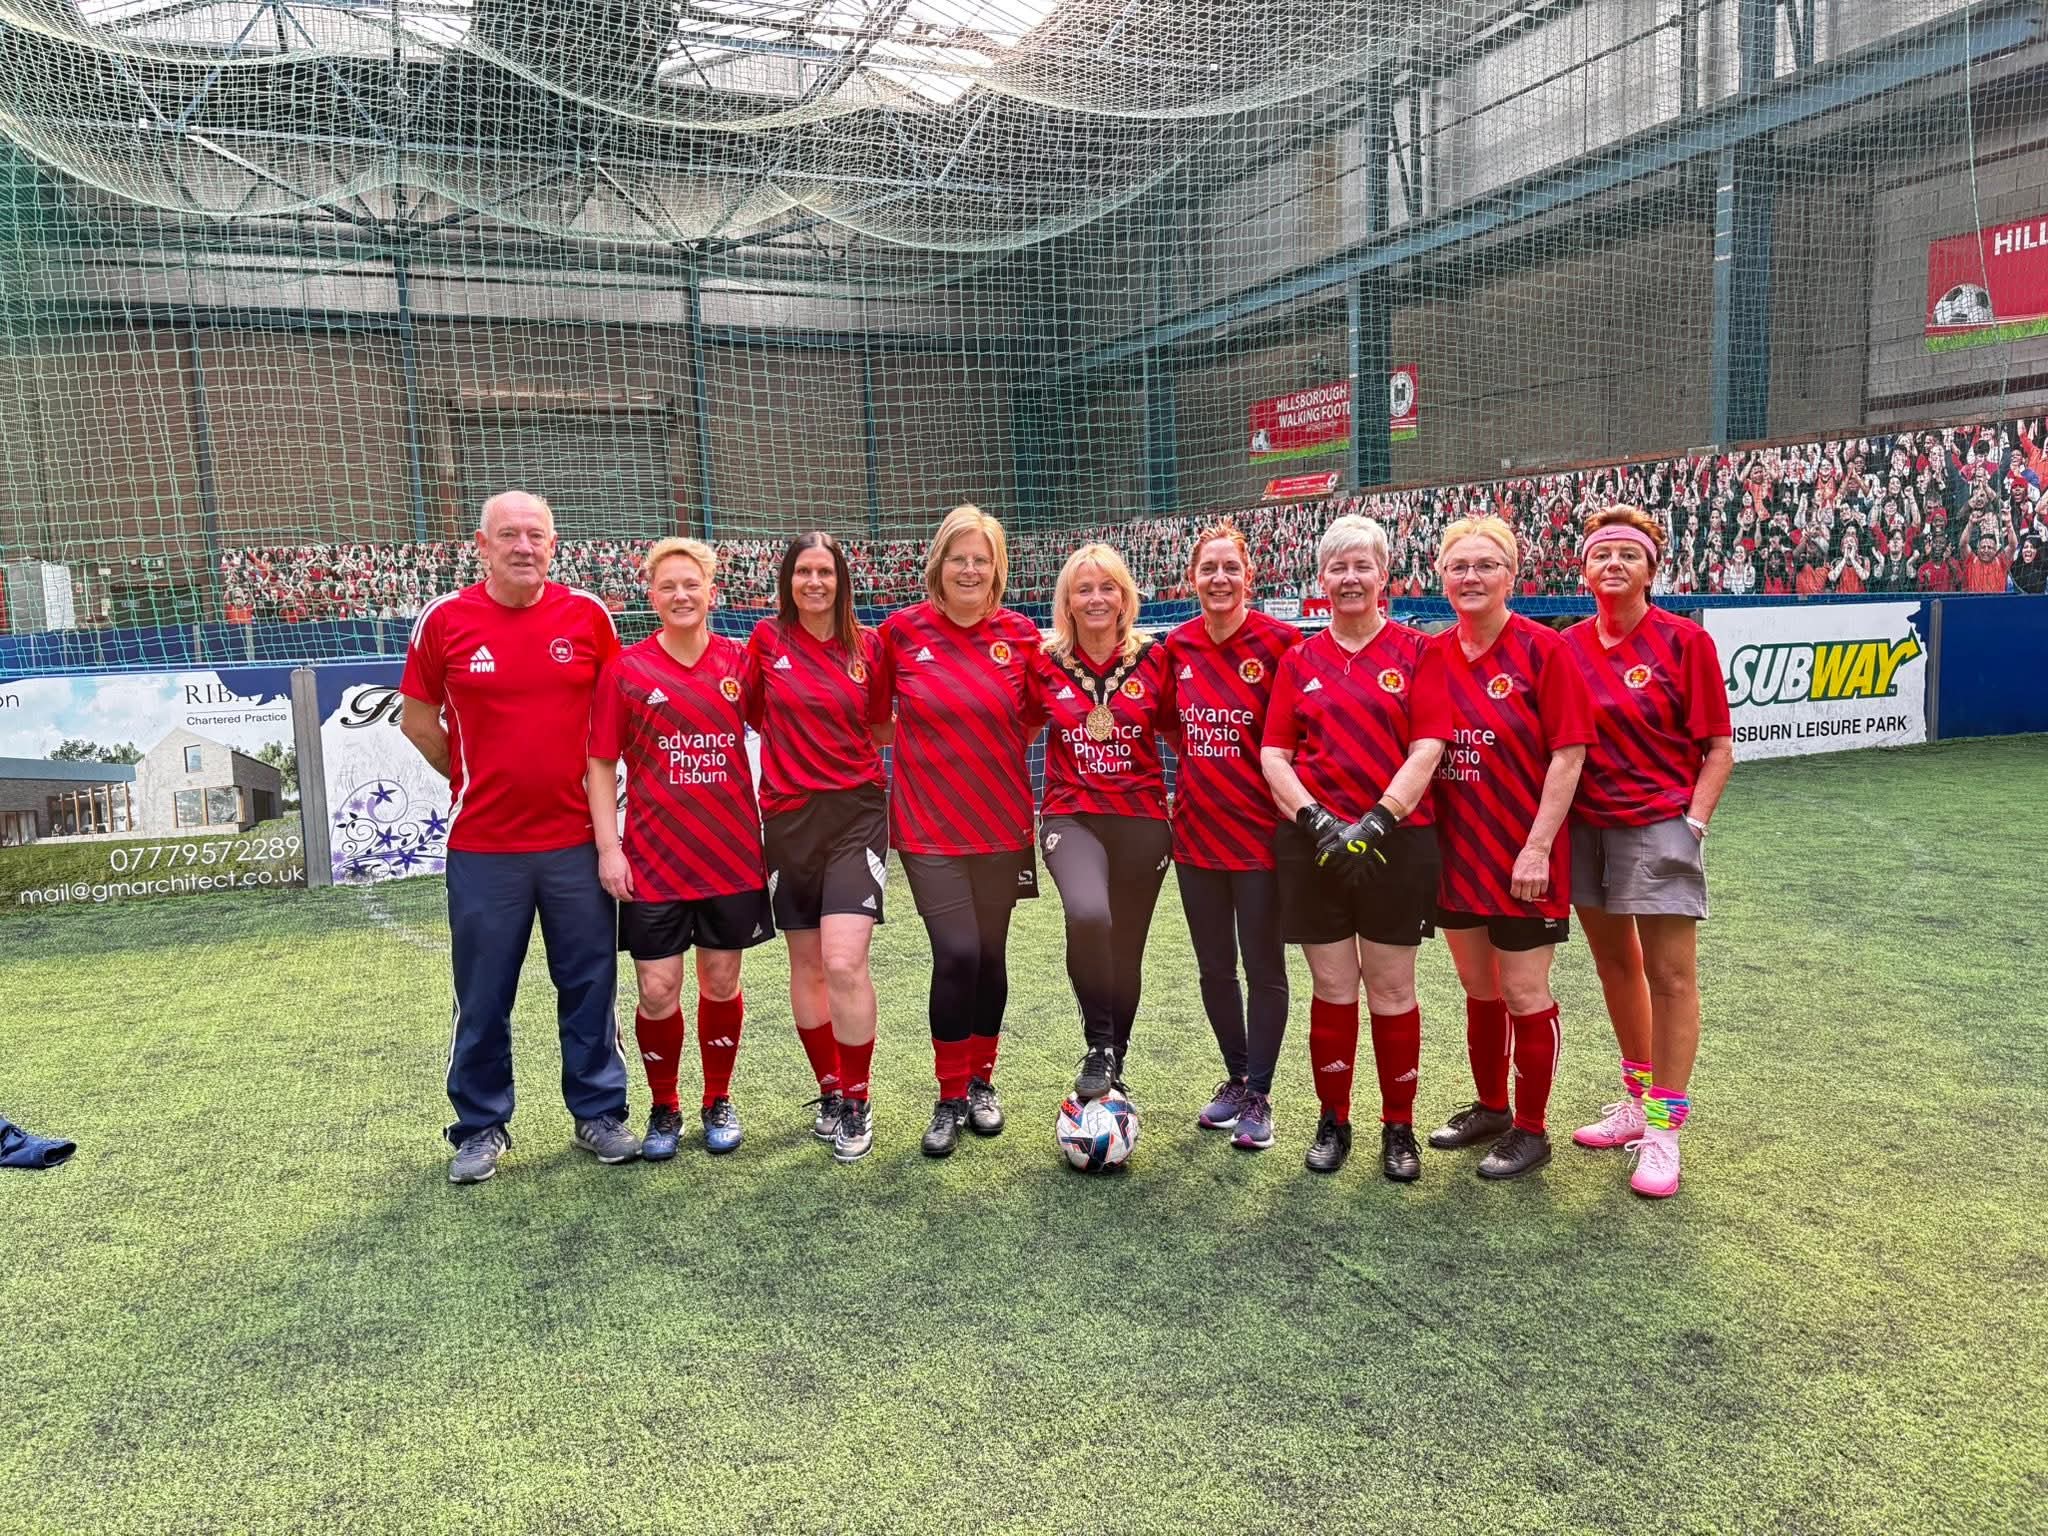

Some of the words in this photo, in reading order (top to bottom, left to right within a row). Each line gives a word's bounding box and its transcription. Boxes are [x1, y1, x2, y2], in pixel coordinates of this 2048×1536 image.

[1277, 383, 1348, 413] HILLSBOROUGH
[1279, 407, 1320, 428] WALKING
[469, 660, 496, 673] HM
[1727, 628, 1922, 707] SUBWAY
[184, 683, 253, 705] RIB
[186, 713, 241, 726] Chartered
[244, 711, 288, 723] Practice
[1178, 703, 1254, 725] advance
[657, 729, 736, 750] advance
[1060, 722, 1143, 743] advnce
[1186, 723, 1240, 745] Physio
[1452, 728, 1496, 746] ance
[1732, 722, 1792, 743] ISBURN
[1796, 717, 1861, 739] LEISURE
[1866, 715, 1908, 733] PARK
[669, 749, 727, 771] Physio
[1074, 740, 1132, 761] Physio
[1187, 741, 1241, 758] Lisburn
[1442, 745, 1481, 768] ysio
[669, 768, 728, 785] Lisburn
[1077, 759, 1132, 776] Lisburn
[110, 835, 301, 873] 07779572289
[20, 864, 305, 905] mail@gmarchitect.co.uk
